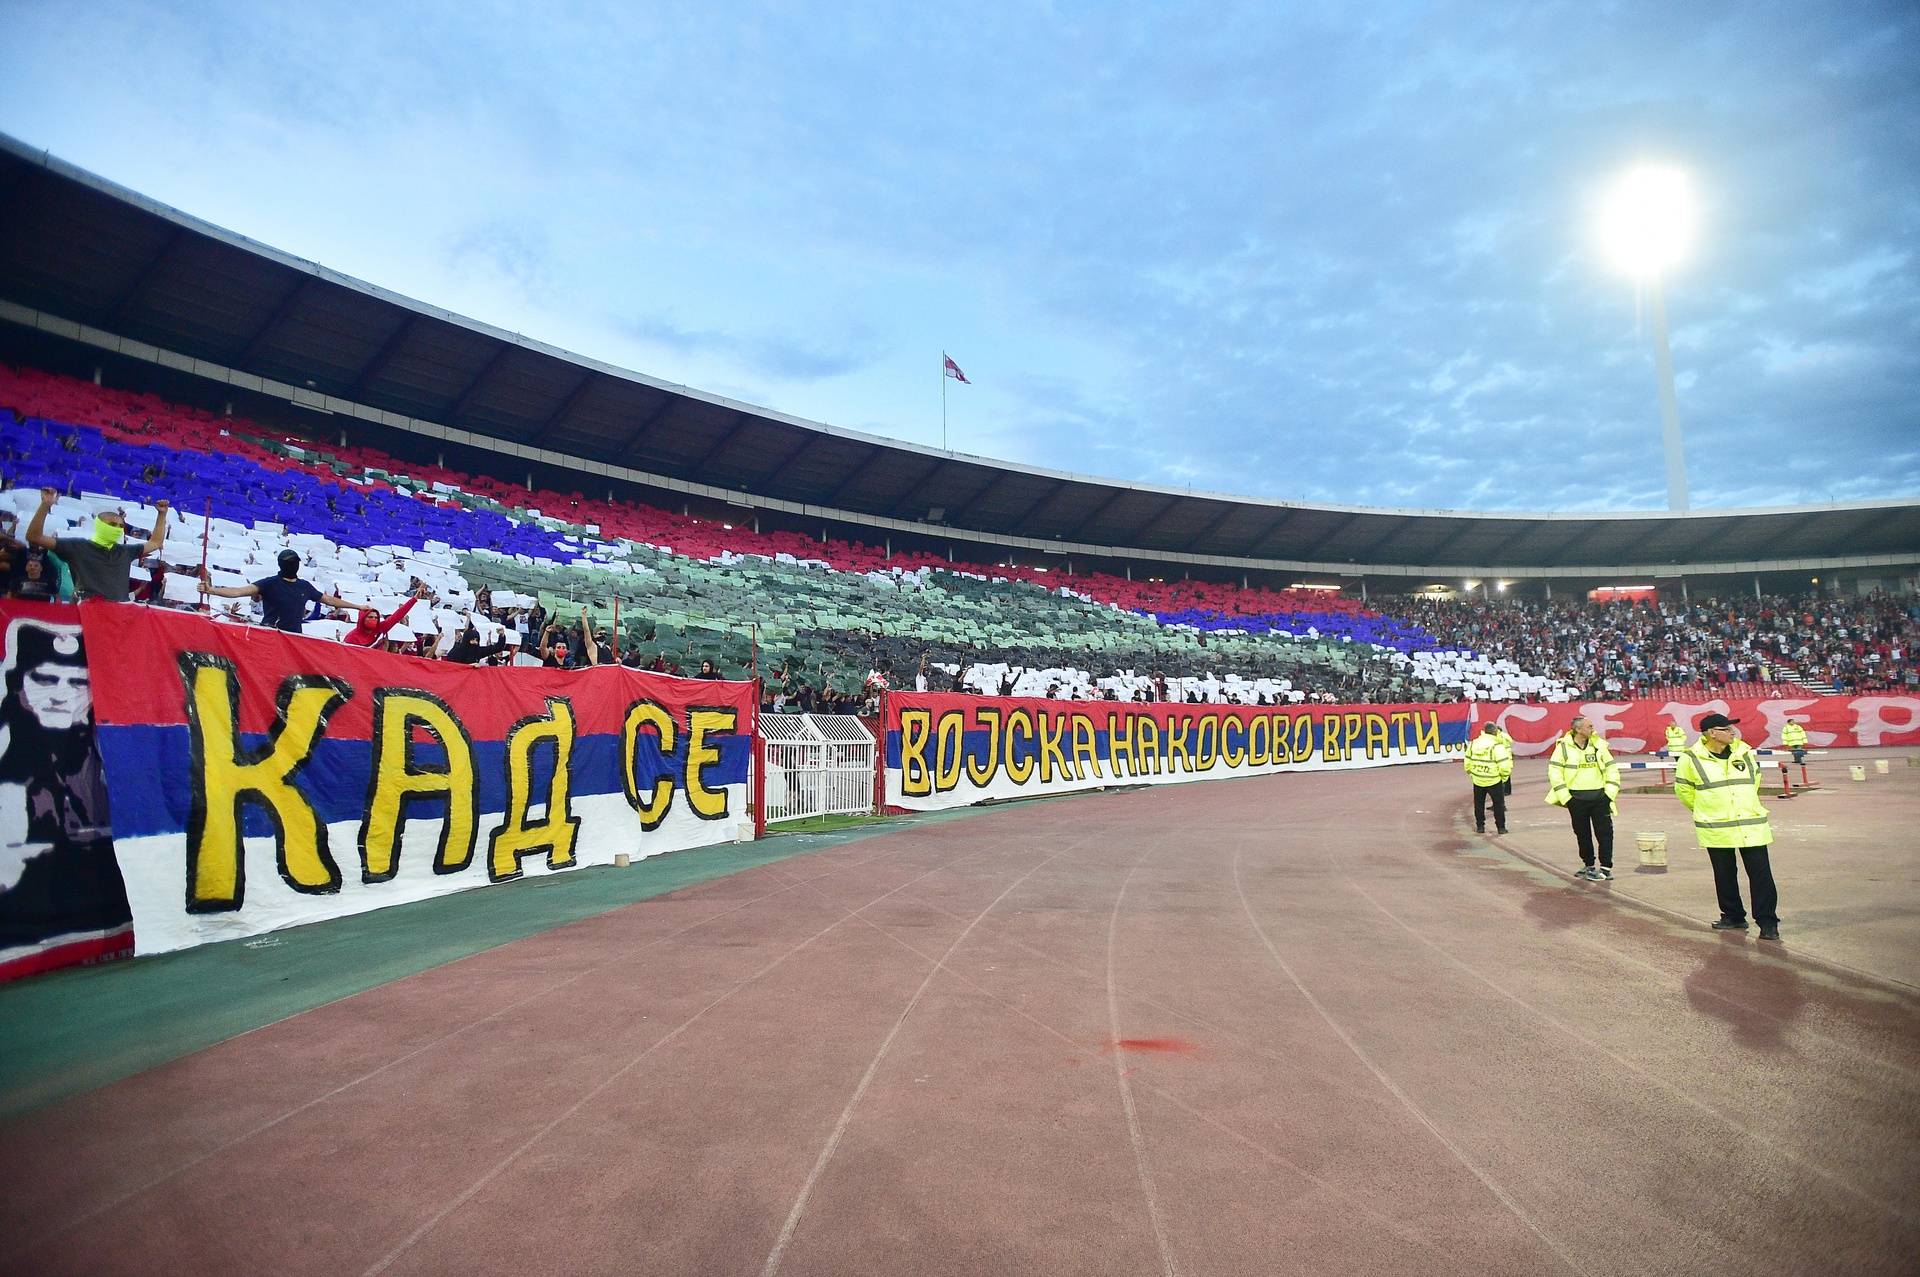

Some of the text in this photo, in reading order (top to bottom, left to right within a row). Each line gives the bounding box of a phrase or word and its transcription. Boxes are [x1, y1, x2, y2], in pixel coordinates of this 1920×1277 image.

[181, 651, 738, 914] КАД СЕ
[900, 707, 1103, 797] ВОЈСКА
[1107, 708, 1161, 778] НА
[1167, 706, 1315, 773] КОСОВО
